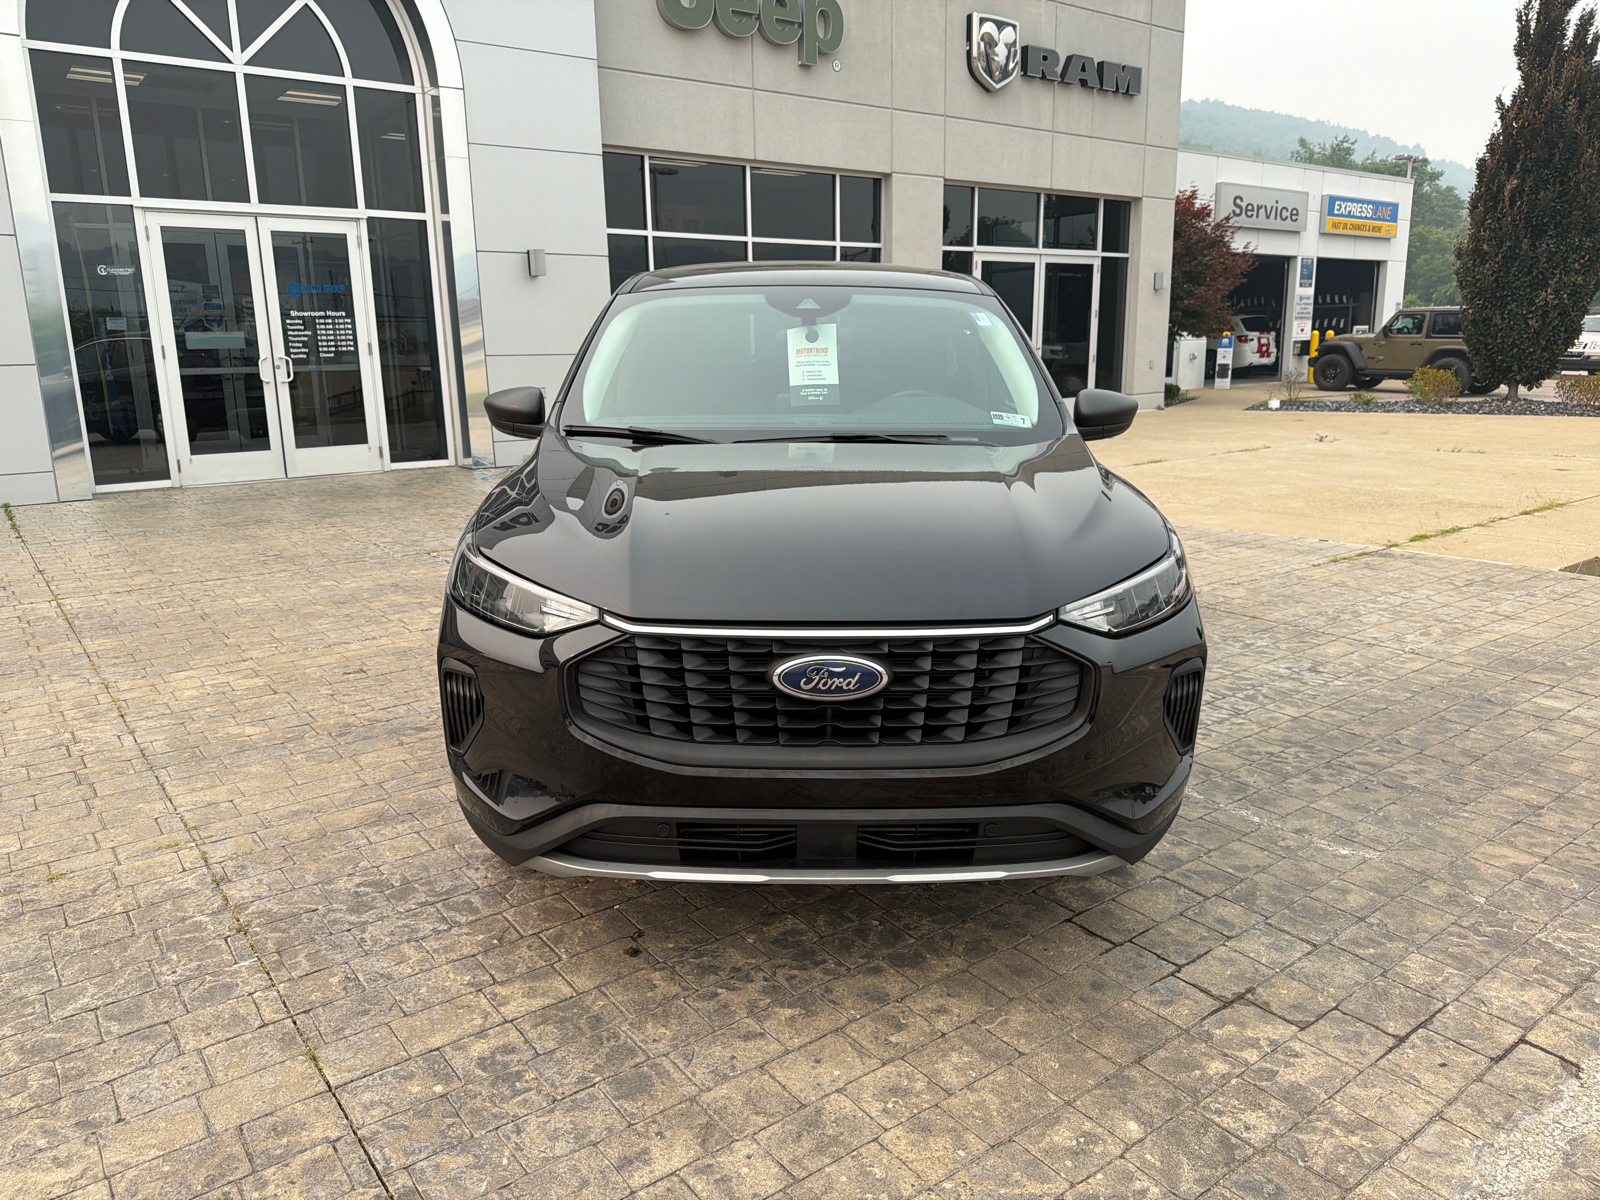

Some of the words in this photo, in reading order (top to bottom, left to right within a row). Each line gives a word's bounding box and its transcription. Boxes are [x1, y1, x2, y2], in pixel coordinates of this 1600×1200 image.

[1021, 44, 1142, 96] RAM
[1232, 195, 1300, 222] Service
[1349, 223, 1368, 232] CHANGES
[304, 285, 321, 293] AUTO
[324, 285, 345, 293] GROUP
[800, 666, 861, 690] Ford
